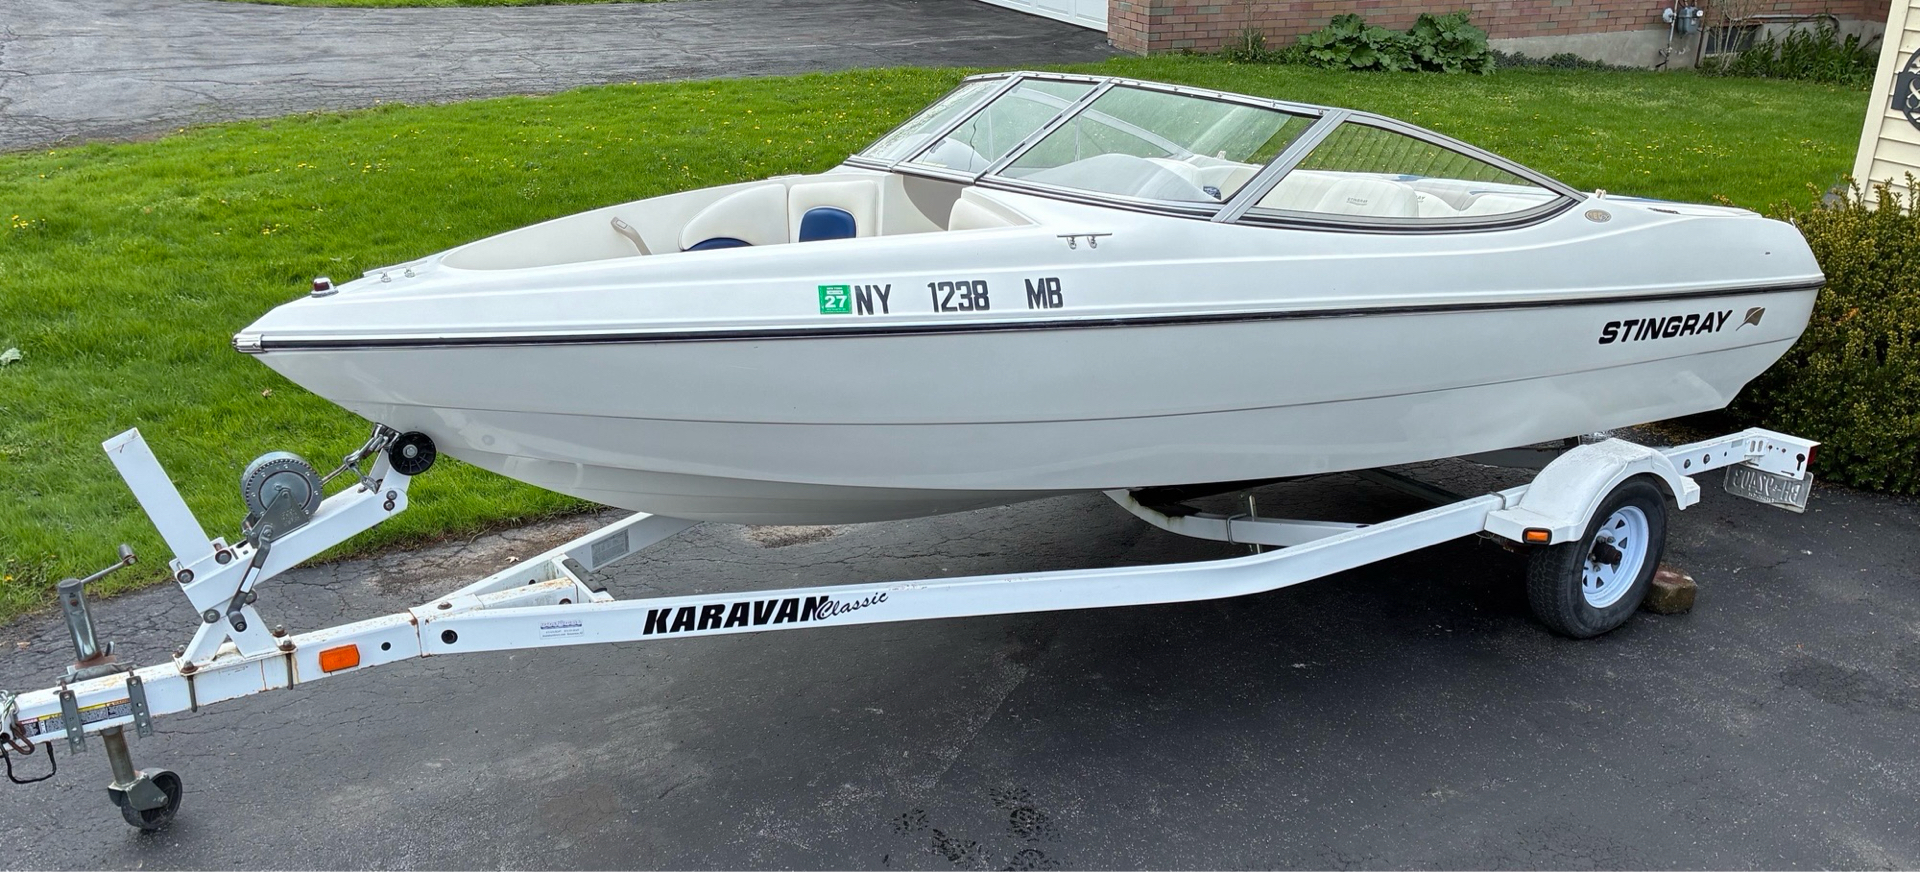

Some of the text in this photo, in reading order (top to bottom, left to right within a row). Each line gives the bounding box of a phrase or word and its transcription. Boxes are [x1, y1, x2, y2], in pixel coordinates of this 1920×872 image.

[824, 295, 848, 308] 27
[854, 277, 1064, 315] NY 1238 MB
[1598, 309, 1733, 345] STINGRAY
[642, 592, 889, 636] KARAVAN Classic
